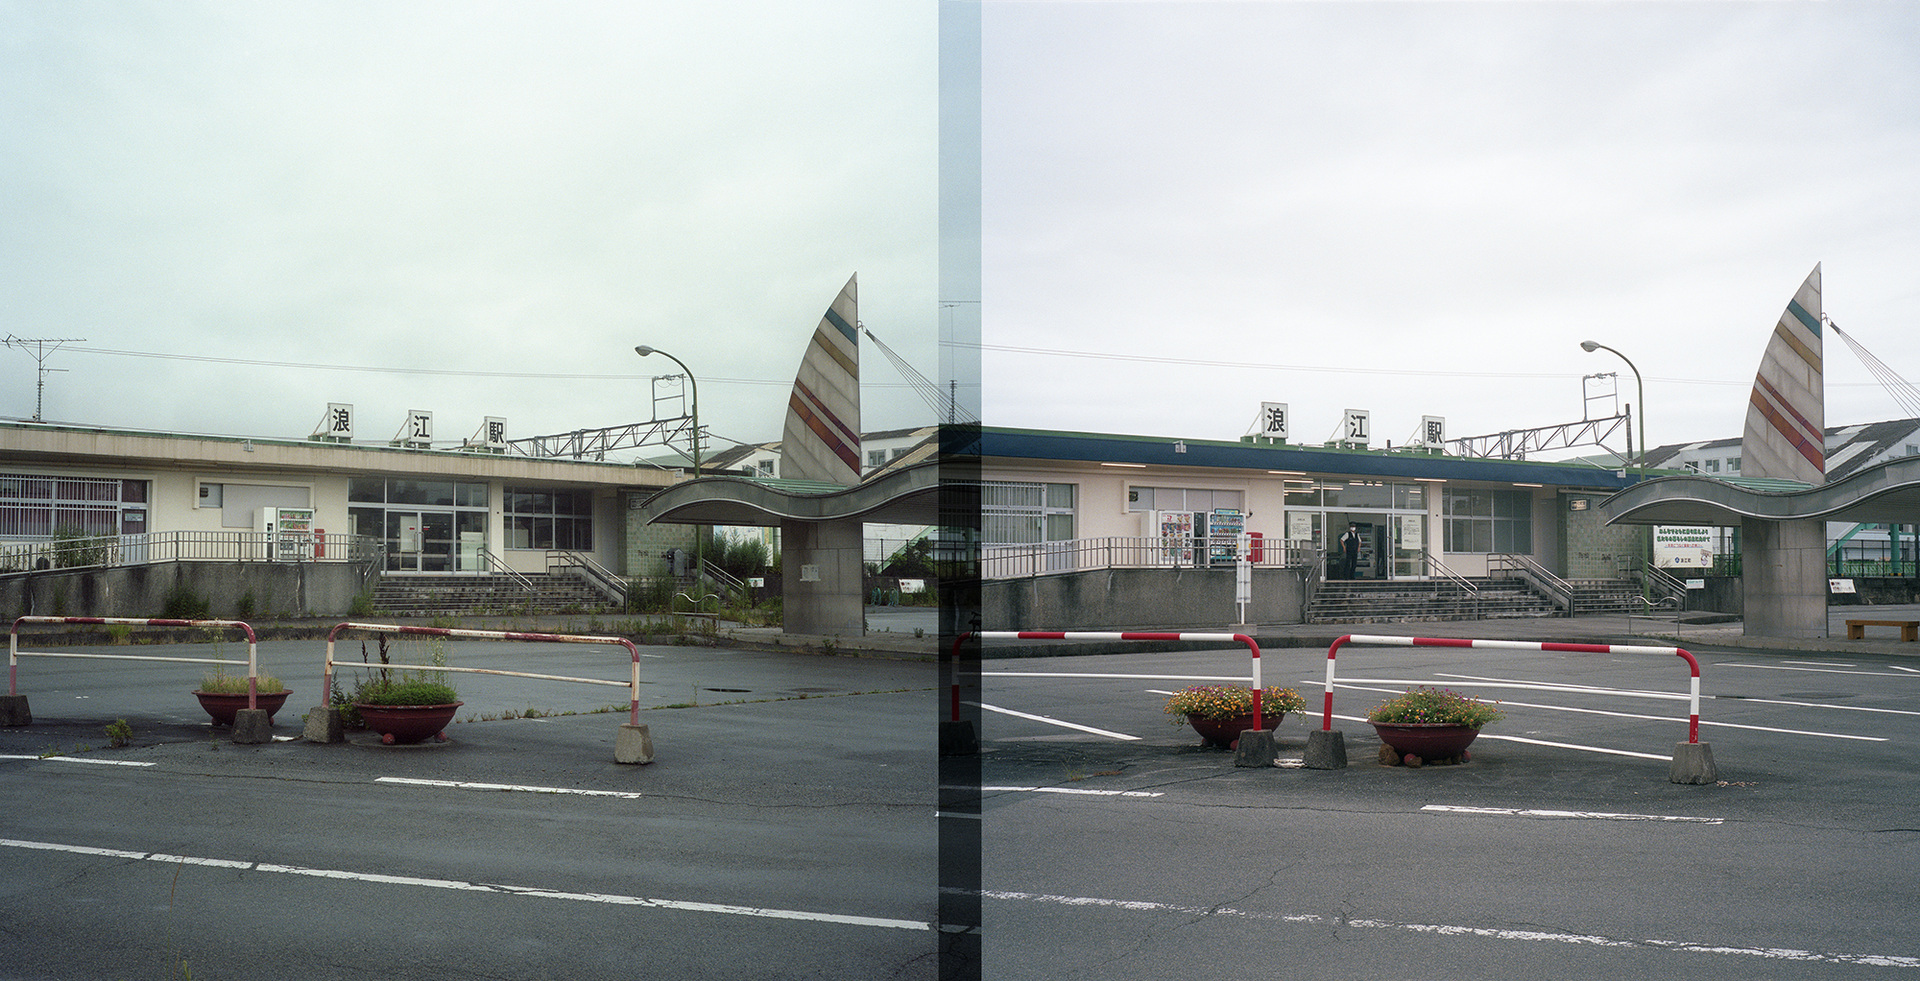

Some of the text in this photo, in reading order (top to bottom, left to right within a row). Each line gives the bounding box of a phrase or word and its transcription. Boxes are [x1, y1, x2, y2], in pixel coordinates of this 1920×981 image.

[332, 408, 504, 444] 浪 江 駅
[1267, 408, 1443, 444] 浪 江 駅
